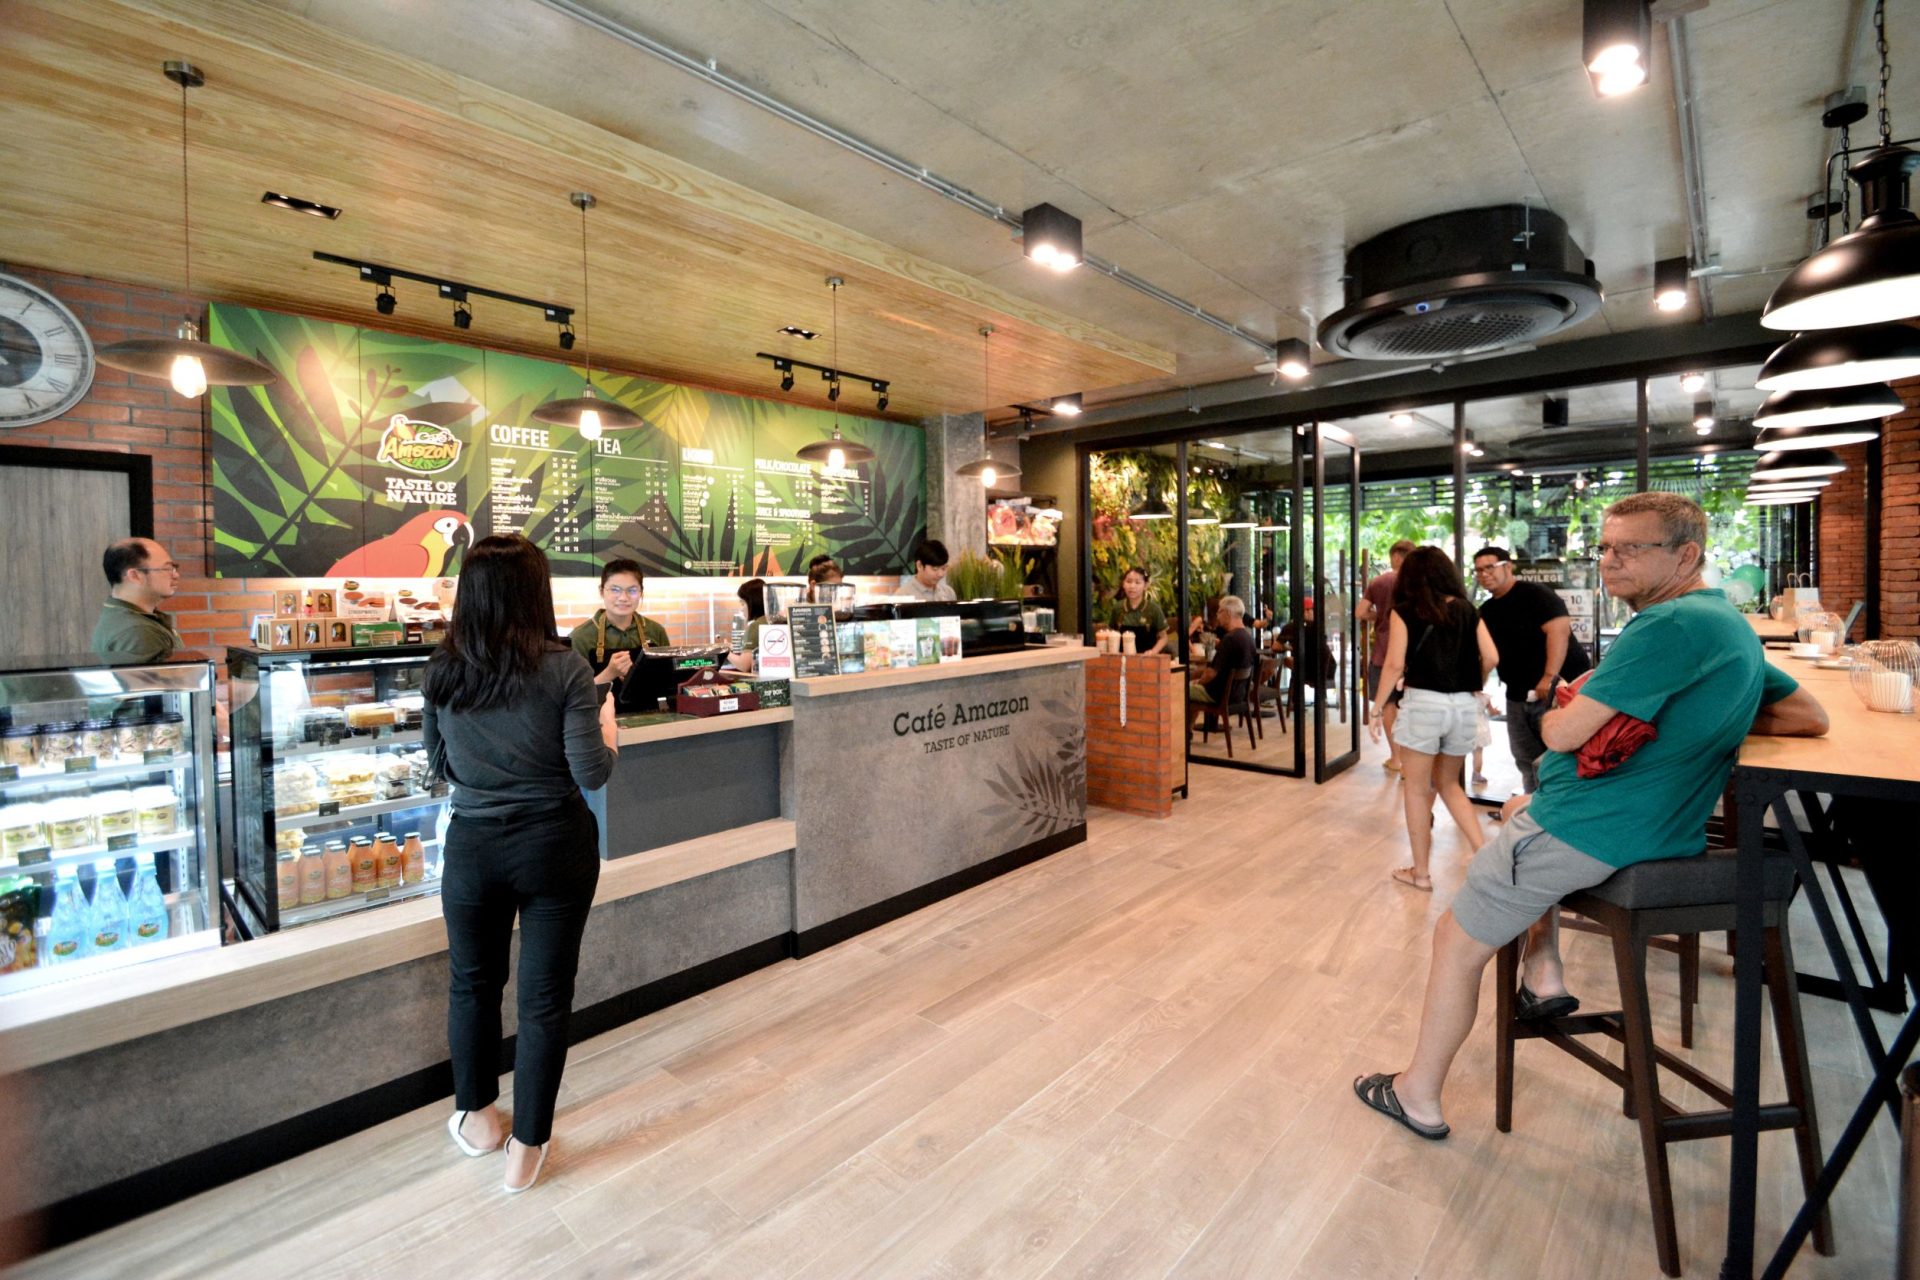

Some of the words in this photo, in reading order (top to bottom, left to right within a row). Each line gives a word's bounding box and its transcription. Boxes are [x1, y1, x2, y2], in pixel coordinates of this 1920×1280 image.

[490, 424, 549, 448] COFFEE
[596, 437, 622, 455] TEA
[385, 477, 432, 491] TASTE
[435, 481, 457, 492] OF
[386, 489, 457, 505] NATURE
[1570, 595, 1582, 605] 10
[1572, 623, 1587, 632] 20
[893, 703, 946, 736] Café
[952, 695, 1029, 726] Amazon
[924, 737, 955, 754] TASTE
[957, 734, 970, 746] OF
[973, 725, 1010, 743] NATURE
